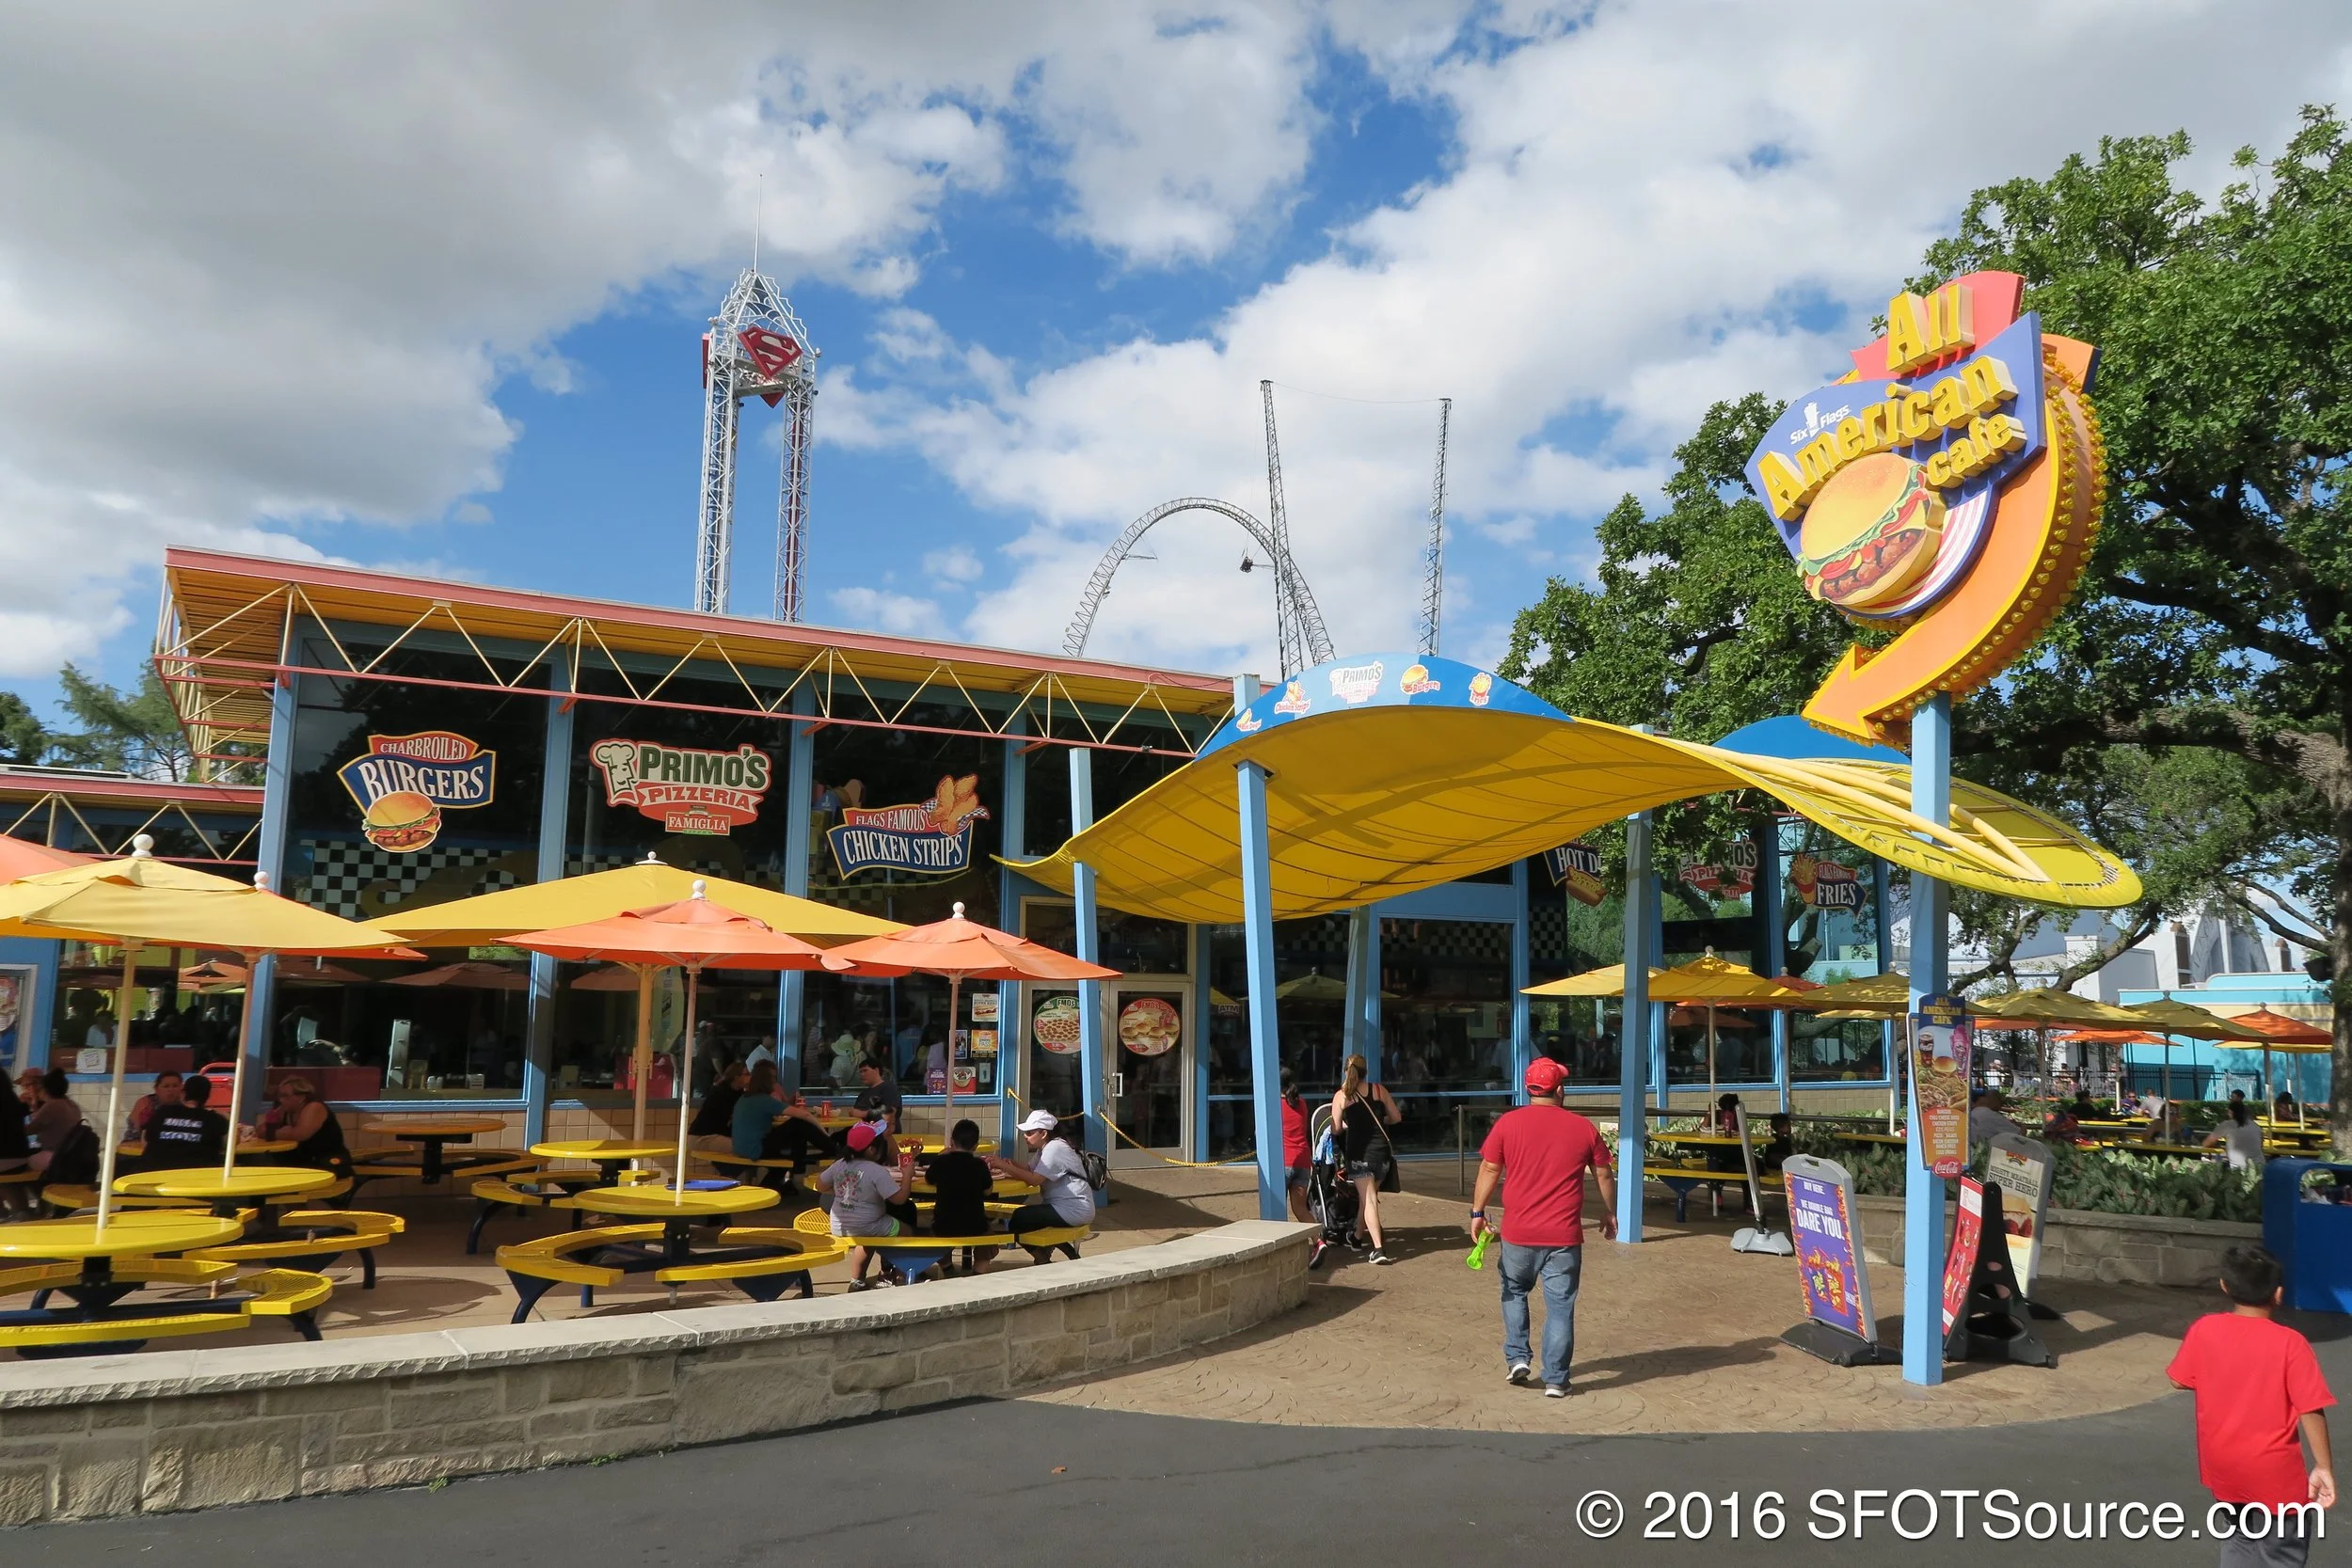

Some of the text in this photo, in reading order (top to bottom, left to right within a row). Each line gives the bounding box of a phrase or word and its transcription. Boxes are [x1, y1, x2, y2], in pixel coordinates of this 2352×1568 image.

[1886, 283, 1972, 372] All
[1756, 355, 2013, 520] American
[1790, 404, 1850, 445] Six Flags
[1927, 414, 2021, 487] cafe
[1412, 681, 1440, 693] Burgers
[380, 736, 468, 760] CHARBROILED
[358, 759, 484, 800] BURGERS
[639, 746, 767, 788] PRIMO'S
[647, 786, 750, 810] PIZZERIA
[668, 816, 727, 831] FAMIGLIA
[855, 808, 927, 832] FLAGS FAMOUS
[843, 831, 962, 866] CHICKEN STRIPS
[1555, 847, 1584, 874] HOT
[1817, 882, 1856, 905] FRIES
[1922, 1006, 1963, 1016] AMERICAN
[1988, 1172, 2039, 1197] SUPER HERO
[1990, 1165, 2039, 1186] MIGHTY MEATBALL
[1795, 1207, 1846, 1241] DARE YOU.
